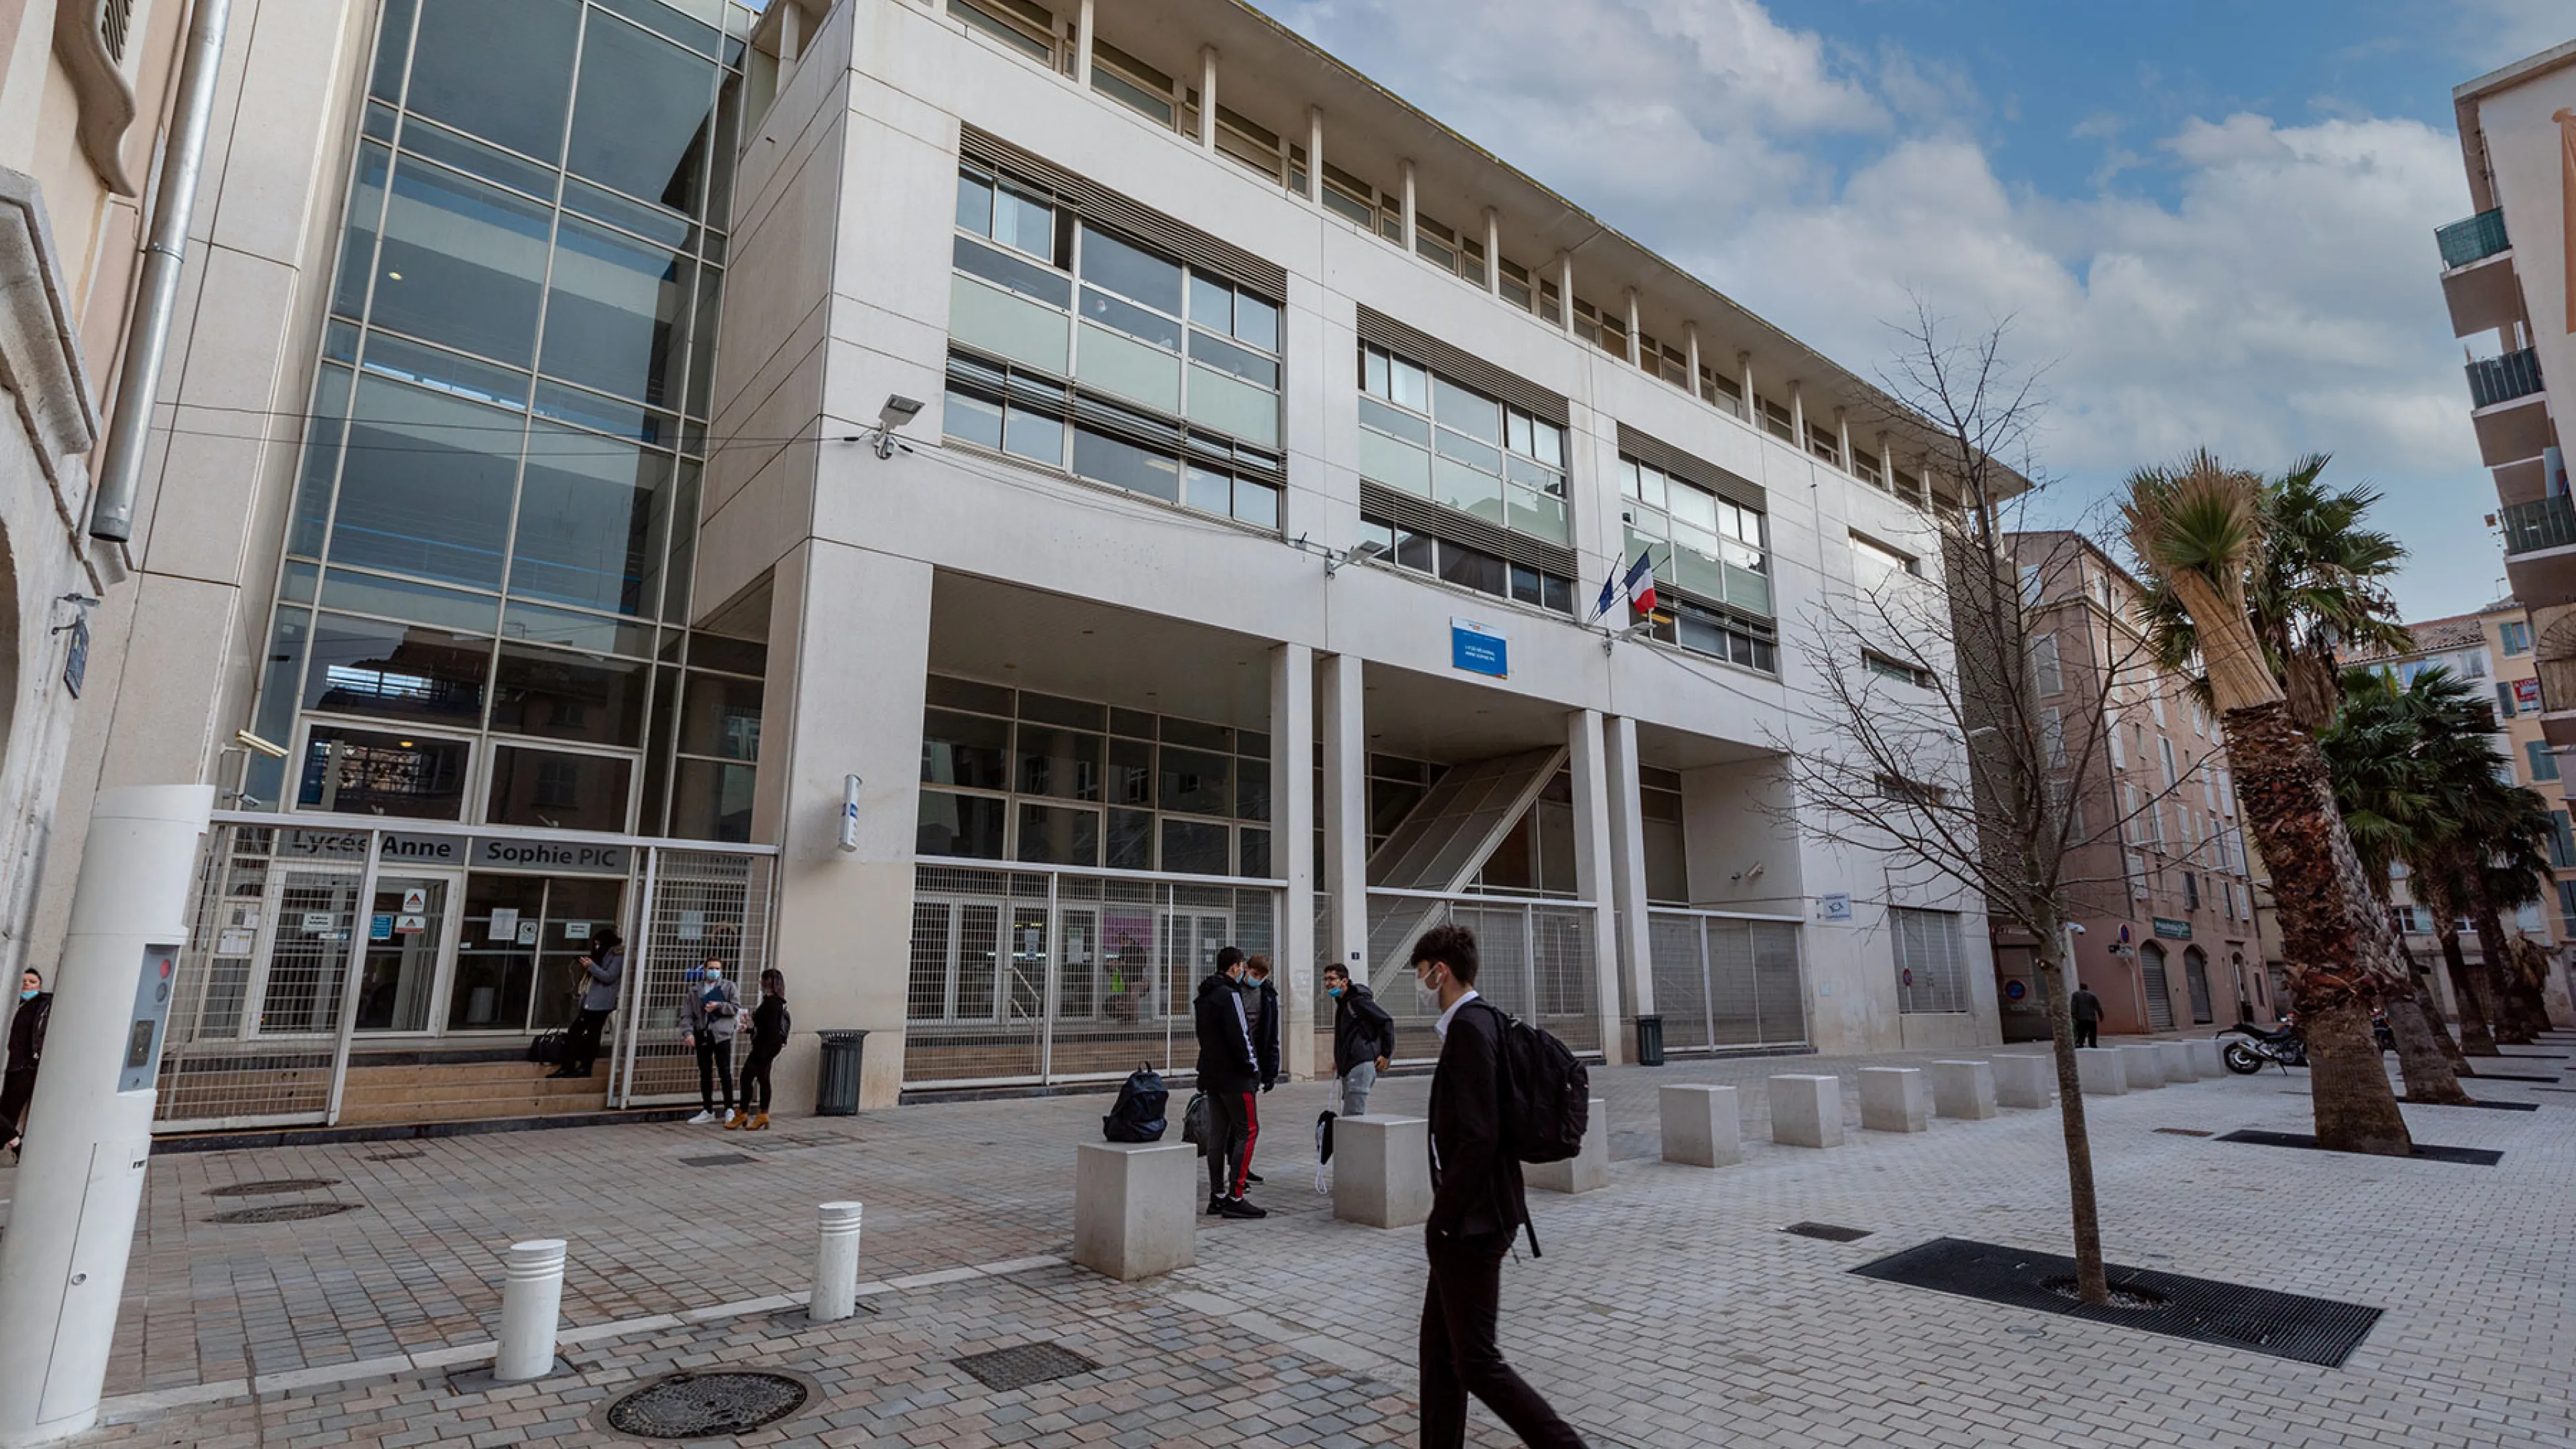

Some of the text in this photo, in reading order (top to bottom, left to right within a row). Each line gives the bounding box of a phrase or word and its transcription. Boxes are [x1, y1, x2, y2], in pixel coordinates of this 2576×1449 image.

[292, 830, 617, 867] Lycée Anne Sophie PIC
